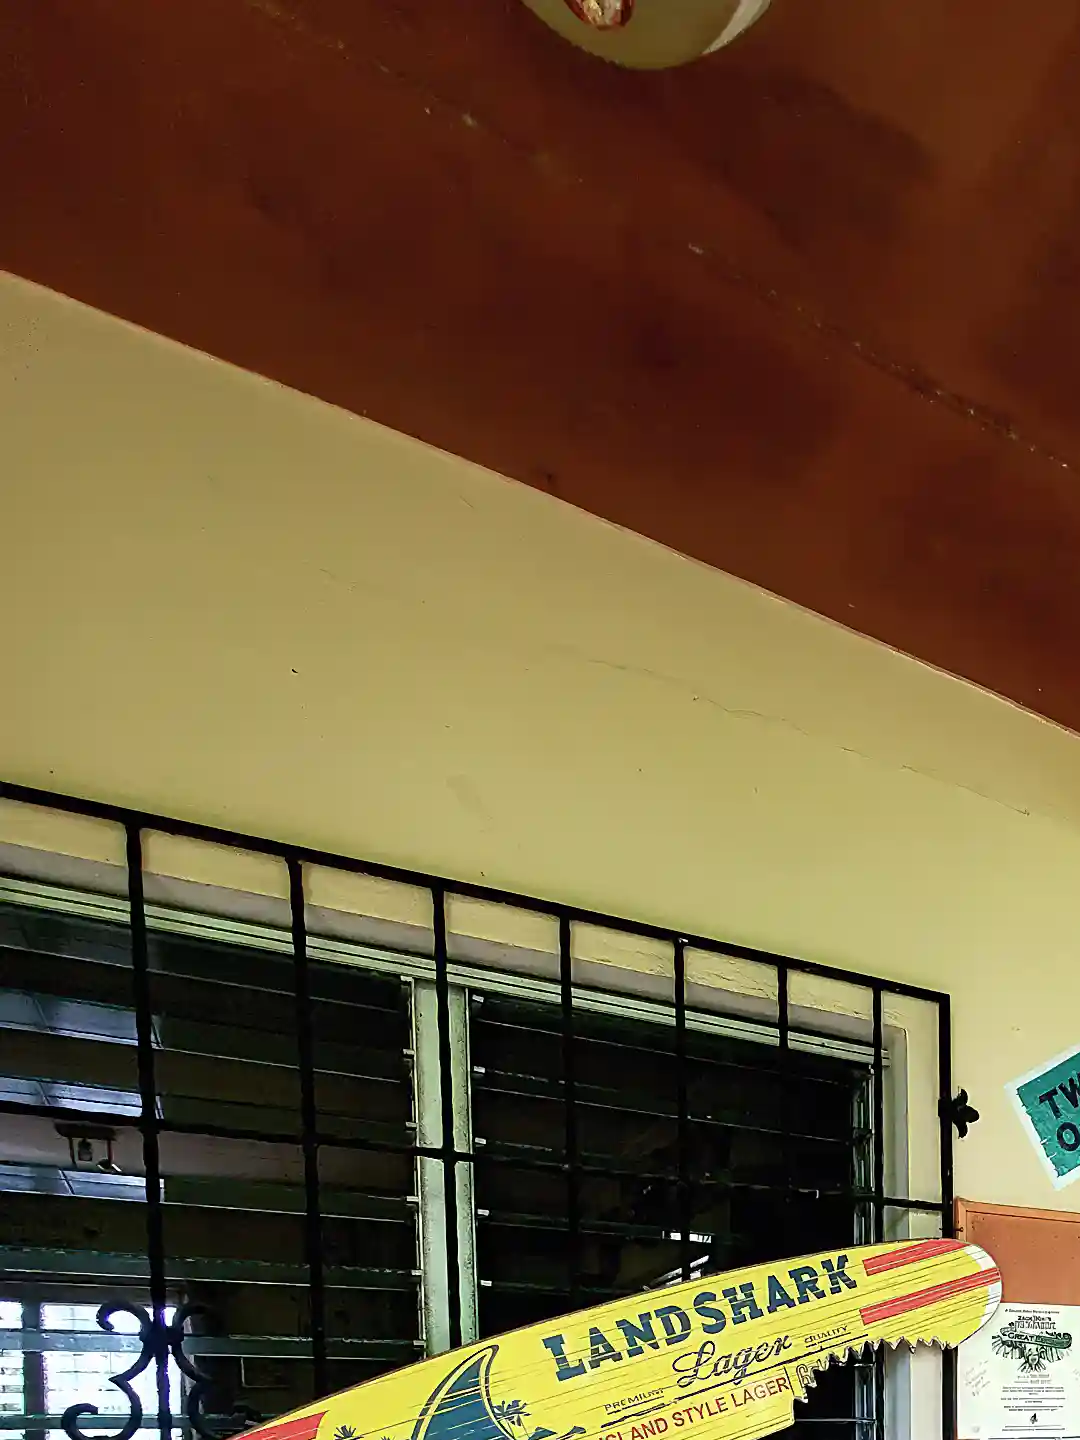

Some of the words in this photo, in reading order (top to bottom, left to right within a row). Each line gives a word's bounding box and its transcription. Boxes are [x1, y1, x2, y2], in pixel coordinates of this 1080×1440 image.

[542, 1254, 857, 1382] LANDSHARK
[672, 1335, 792, 1388] Lager
[672, 1396, 728, 1427] STYLE
[731, 1376, 791, 1408] LAGER
